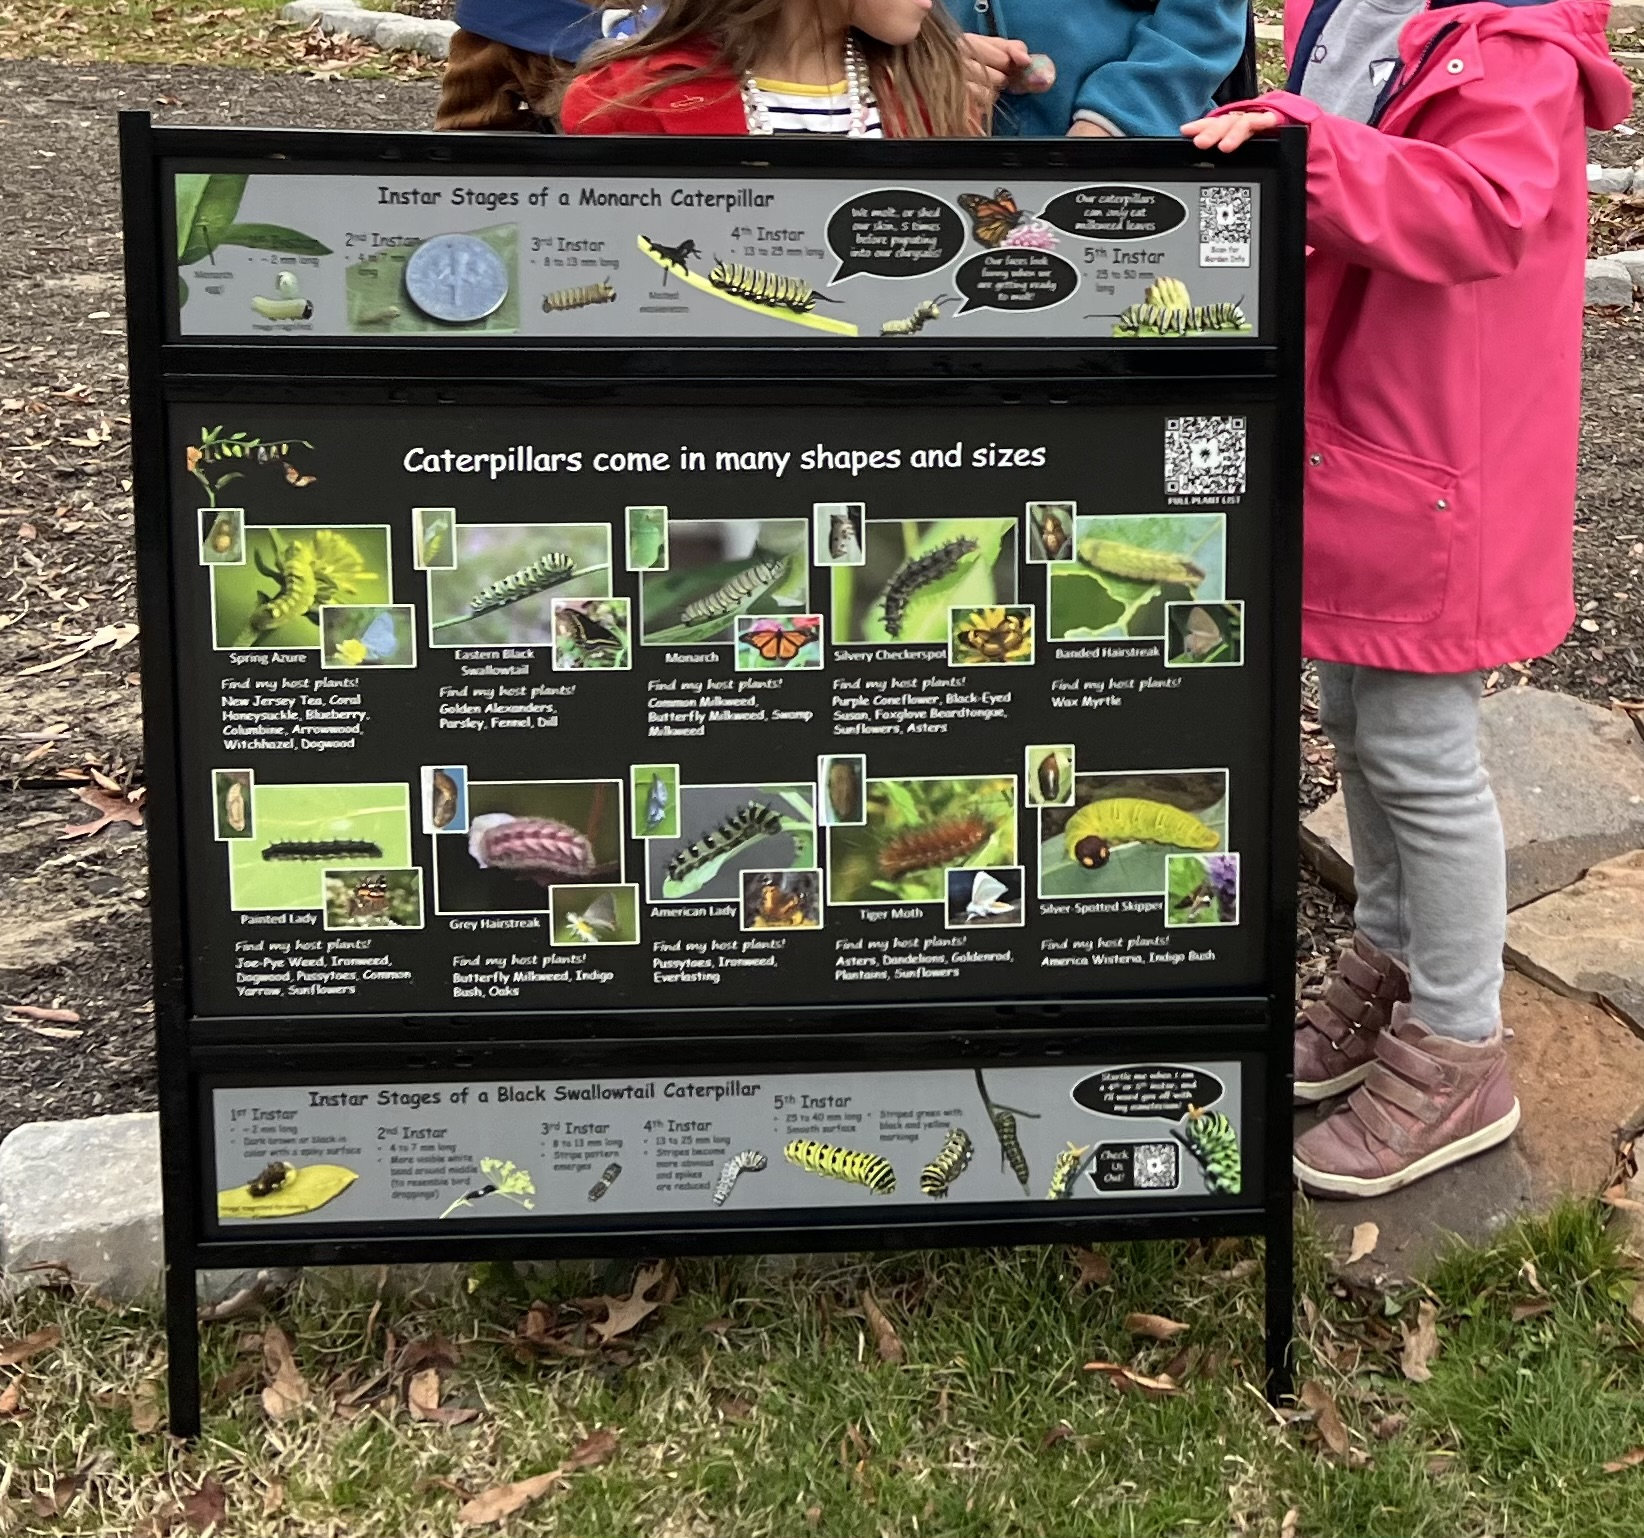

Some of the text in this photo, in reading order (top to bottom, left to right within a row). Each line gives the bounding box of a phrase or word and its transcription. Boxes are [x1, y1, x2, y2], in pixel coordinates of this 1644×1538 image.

[378, 187, 775, 212] Instar Stages of a Monarch Caterpillar
[757, 227, 805, 241] Instar
[557, 237, 605, 252] Instar
[1084, 247, 1164, 264] 5th Instar
[403, 442, 1046, 480] Caterpillars come in many shapes and sizes
[230, 652, 307, 665] Spring Azure
[455, 649, 535, 660] Eastern Black
[665, 652, 719, 663] Monarch
[834, 649, 947, 662] Silvery Checkerspot
[1055, 646, 1160, 659] Banded Hairstreak
[461, 664, 529, 676] Swallowtail
[221, 677, 359, 691] Find my host plants!
[648, 677, 783, 693] Find my host plants!
[833, 676, 966, 691] Find my host plants!
[1051, 677, 1182, 692] Find my host plants!
[439, 684, 576, 699] Find my host plants!
[221, 694, 361, 708] New Jersey Tea, Coral
[648, 696, 759, 708] Common Milkweed,
[832, 692, 1011, 708] Purple Coneflower, Black-Eyed
[1051, 695, 1122, 709] Wax Myrtle
[439, 703, 557, 714] Golden Alexanders,
[833, 707, 1007, 722] Susan, Foxglove Beardtongue,
[222, 710, 370, 722] Honeysuckle, Blueberry,
[648, 709, 813, 724] Butterfly Milkweed, Swamp
[223, 724, 363, 736] Columbine, Arrowwood,
[439, 716, 558, 731] Parsley, Fennel, Dill
[648, 725, 705, 736] Milkweed
[833, 723, 948, 735] Sunflowers, Asters
[223, 738, 355, 751] Witchhazel, Dogwood
[650, 905, 737, 918] American Lady
[1121, 901, 1163, 912] Skipper
[241, 913, 317, 925] Painted Lady
[860, 908, 923, 922] Tiger Moth
[450, 918, 540, 931] Grey Hairstreak
[235, 938, 371, 953] Find my host plants!
[653, 938, 786, 953] Find my host plants!
[835, 936, 967, 951] Find my host plants!
[1041, 935, 1170, 951] Find my host plants!
[235, 955, 392, 970] Joe-Pye Weed, Ironweed,
[453, 953, 586, 968] Find my host plants!
[653, 955, 778, 970] Pussytoes, Ironweed,
[835, 950, 1014, 967] Asters, Dandelions, Goldenrod,
[1041, 949, 1216, 967] America Wisteria, Indigo Bush
[236, 972, 294, 985] Dogwood,
[296, 971, 359, 982] Pussytoes,
[453, 970, 614, 984] Butterfly Milkweed, Indigo
[654, 971, 720, 984] Everlasting
[835, 967, 959, 980] Plantains, Sunflowers
[236, 984, 356, 997] Yarrow, Sunflowers
[453, 986, 519, 998] Bush, Oaks
[309, 1080, 761, 1109] Instar Stages of a Black Swallowtail Caterpillar
[774, 1094, 851, 1109] 5th Instar
[252, 1108, 298, 1121] Instar
[377, 1127, 447, 1139] 2nd Instar
[541, 1122, 610, 1135] 3rd Instar
[644, 1120, 712, 1132] 4th Instar
